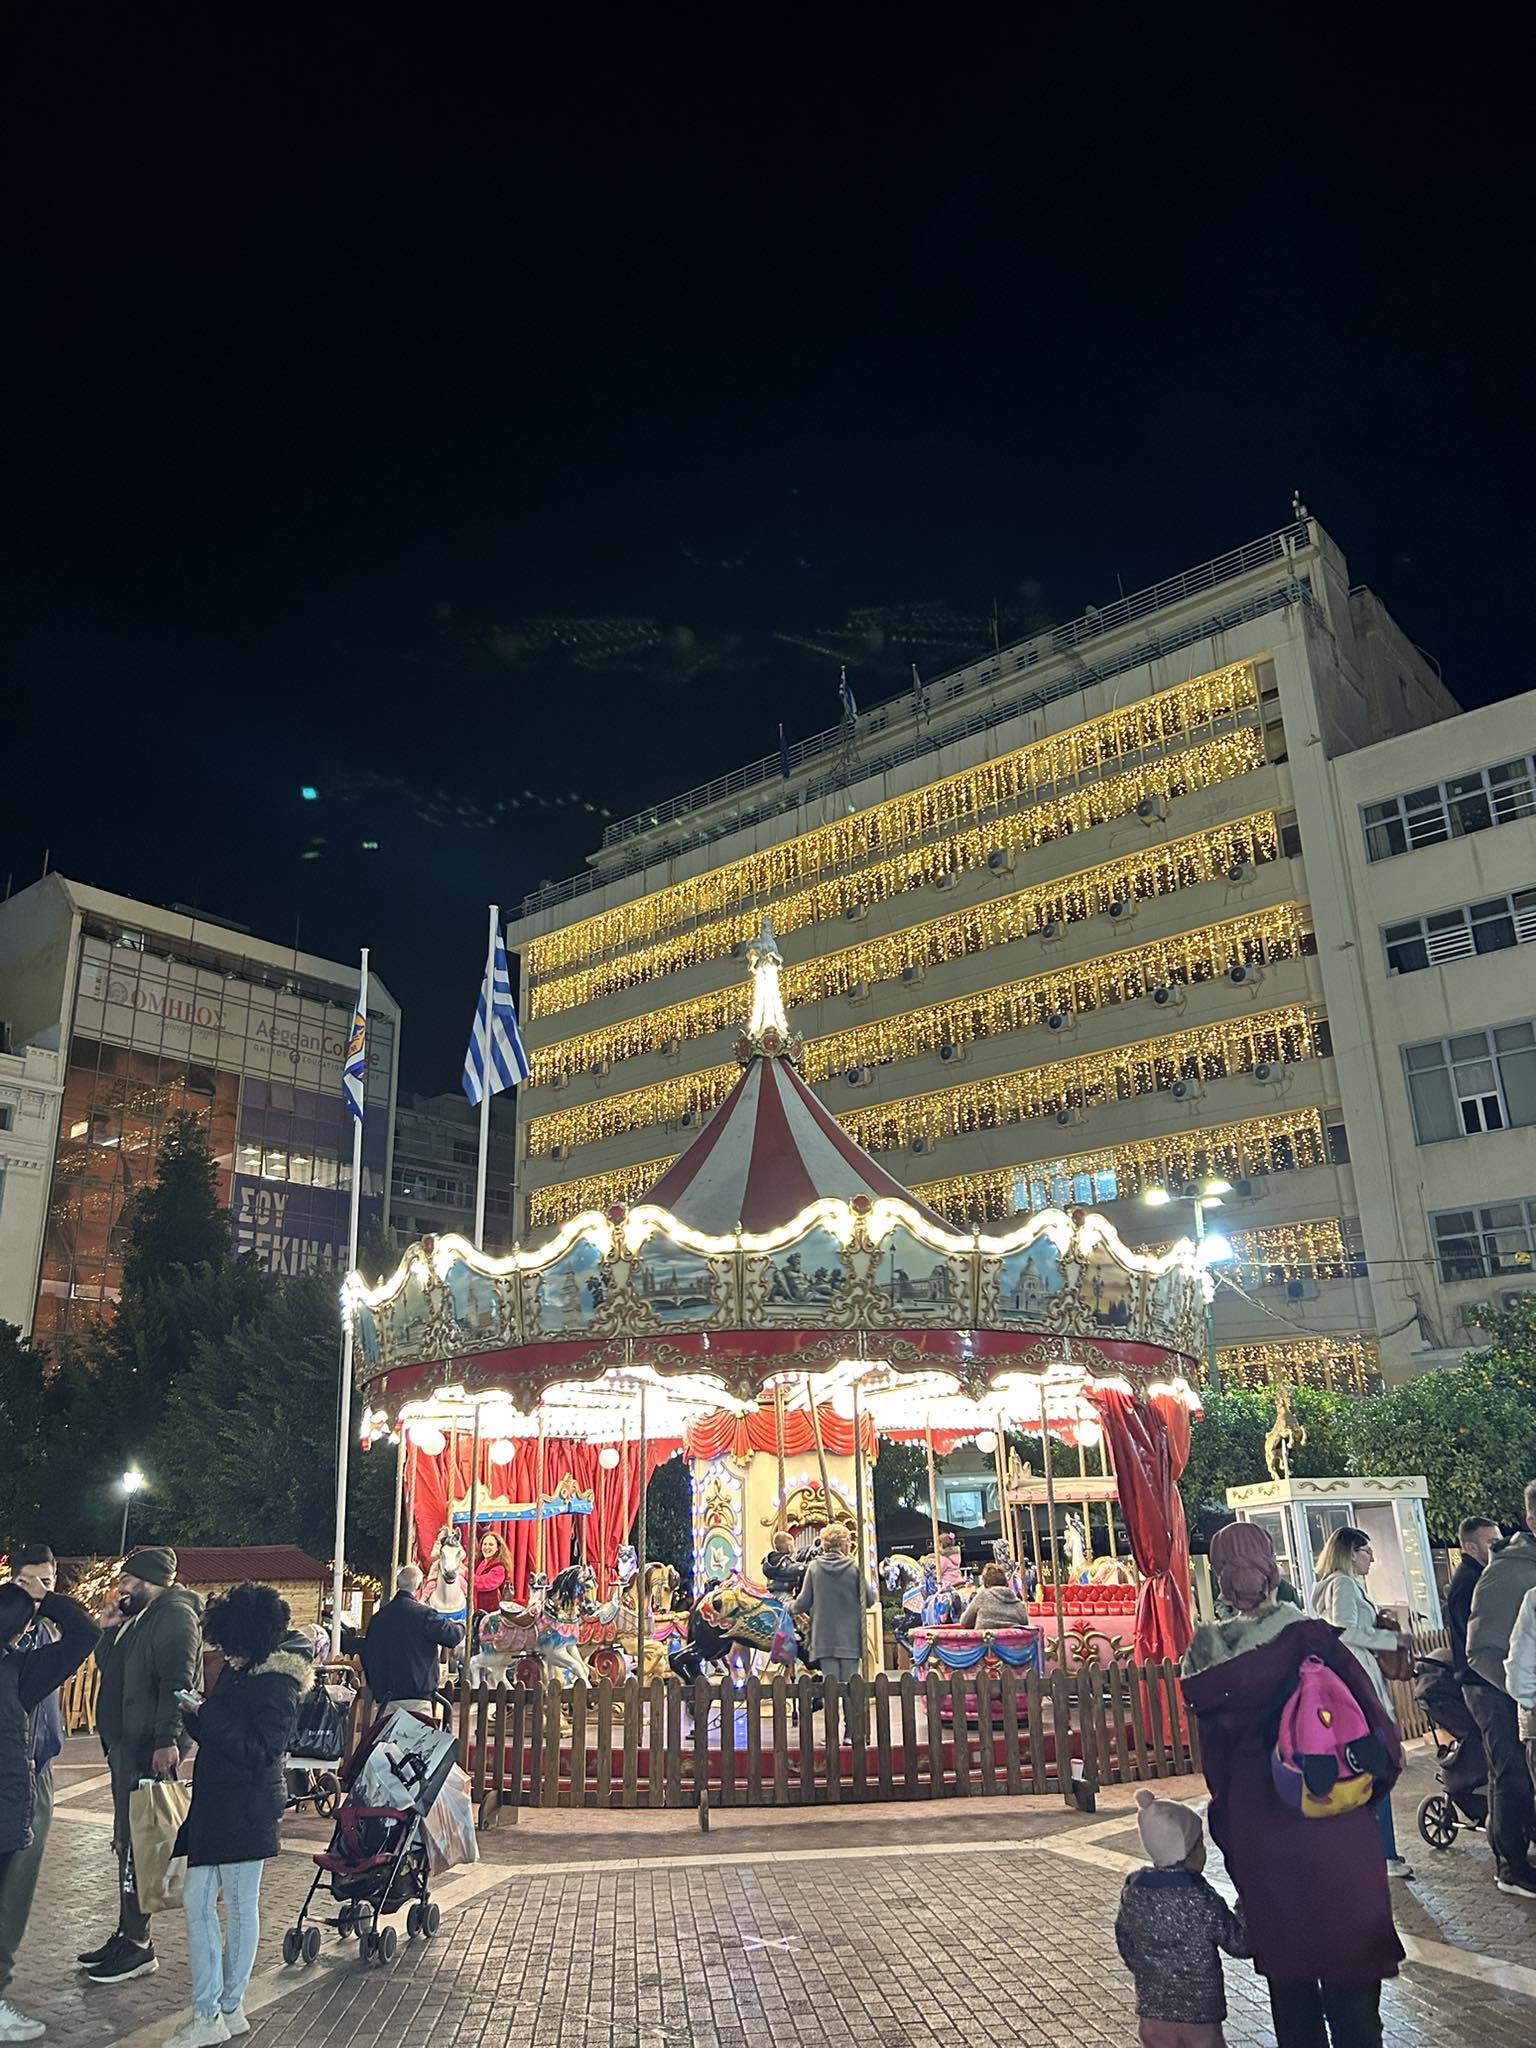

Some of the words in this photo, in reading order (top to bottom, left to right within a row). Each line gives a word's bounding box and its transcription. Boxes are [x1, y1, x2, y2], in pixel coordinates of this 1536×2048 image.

[129, 989, 227, 1030] ΟΜΗΡΟΣ
[238, 1186, 289, 1228] ΣΟΥ
[237, 1229, 351, 1277] ΞΕΚΙΝΑΕ
